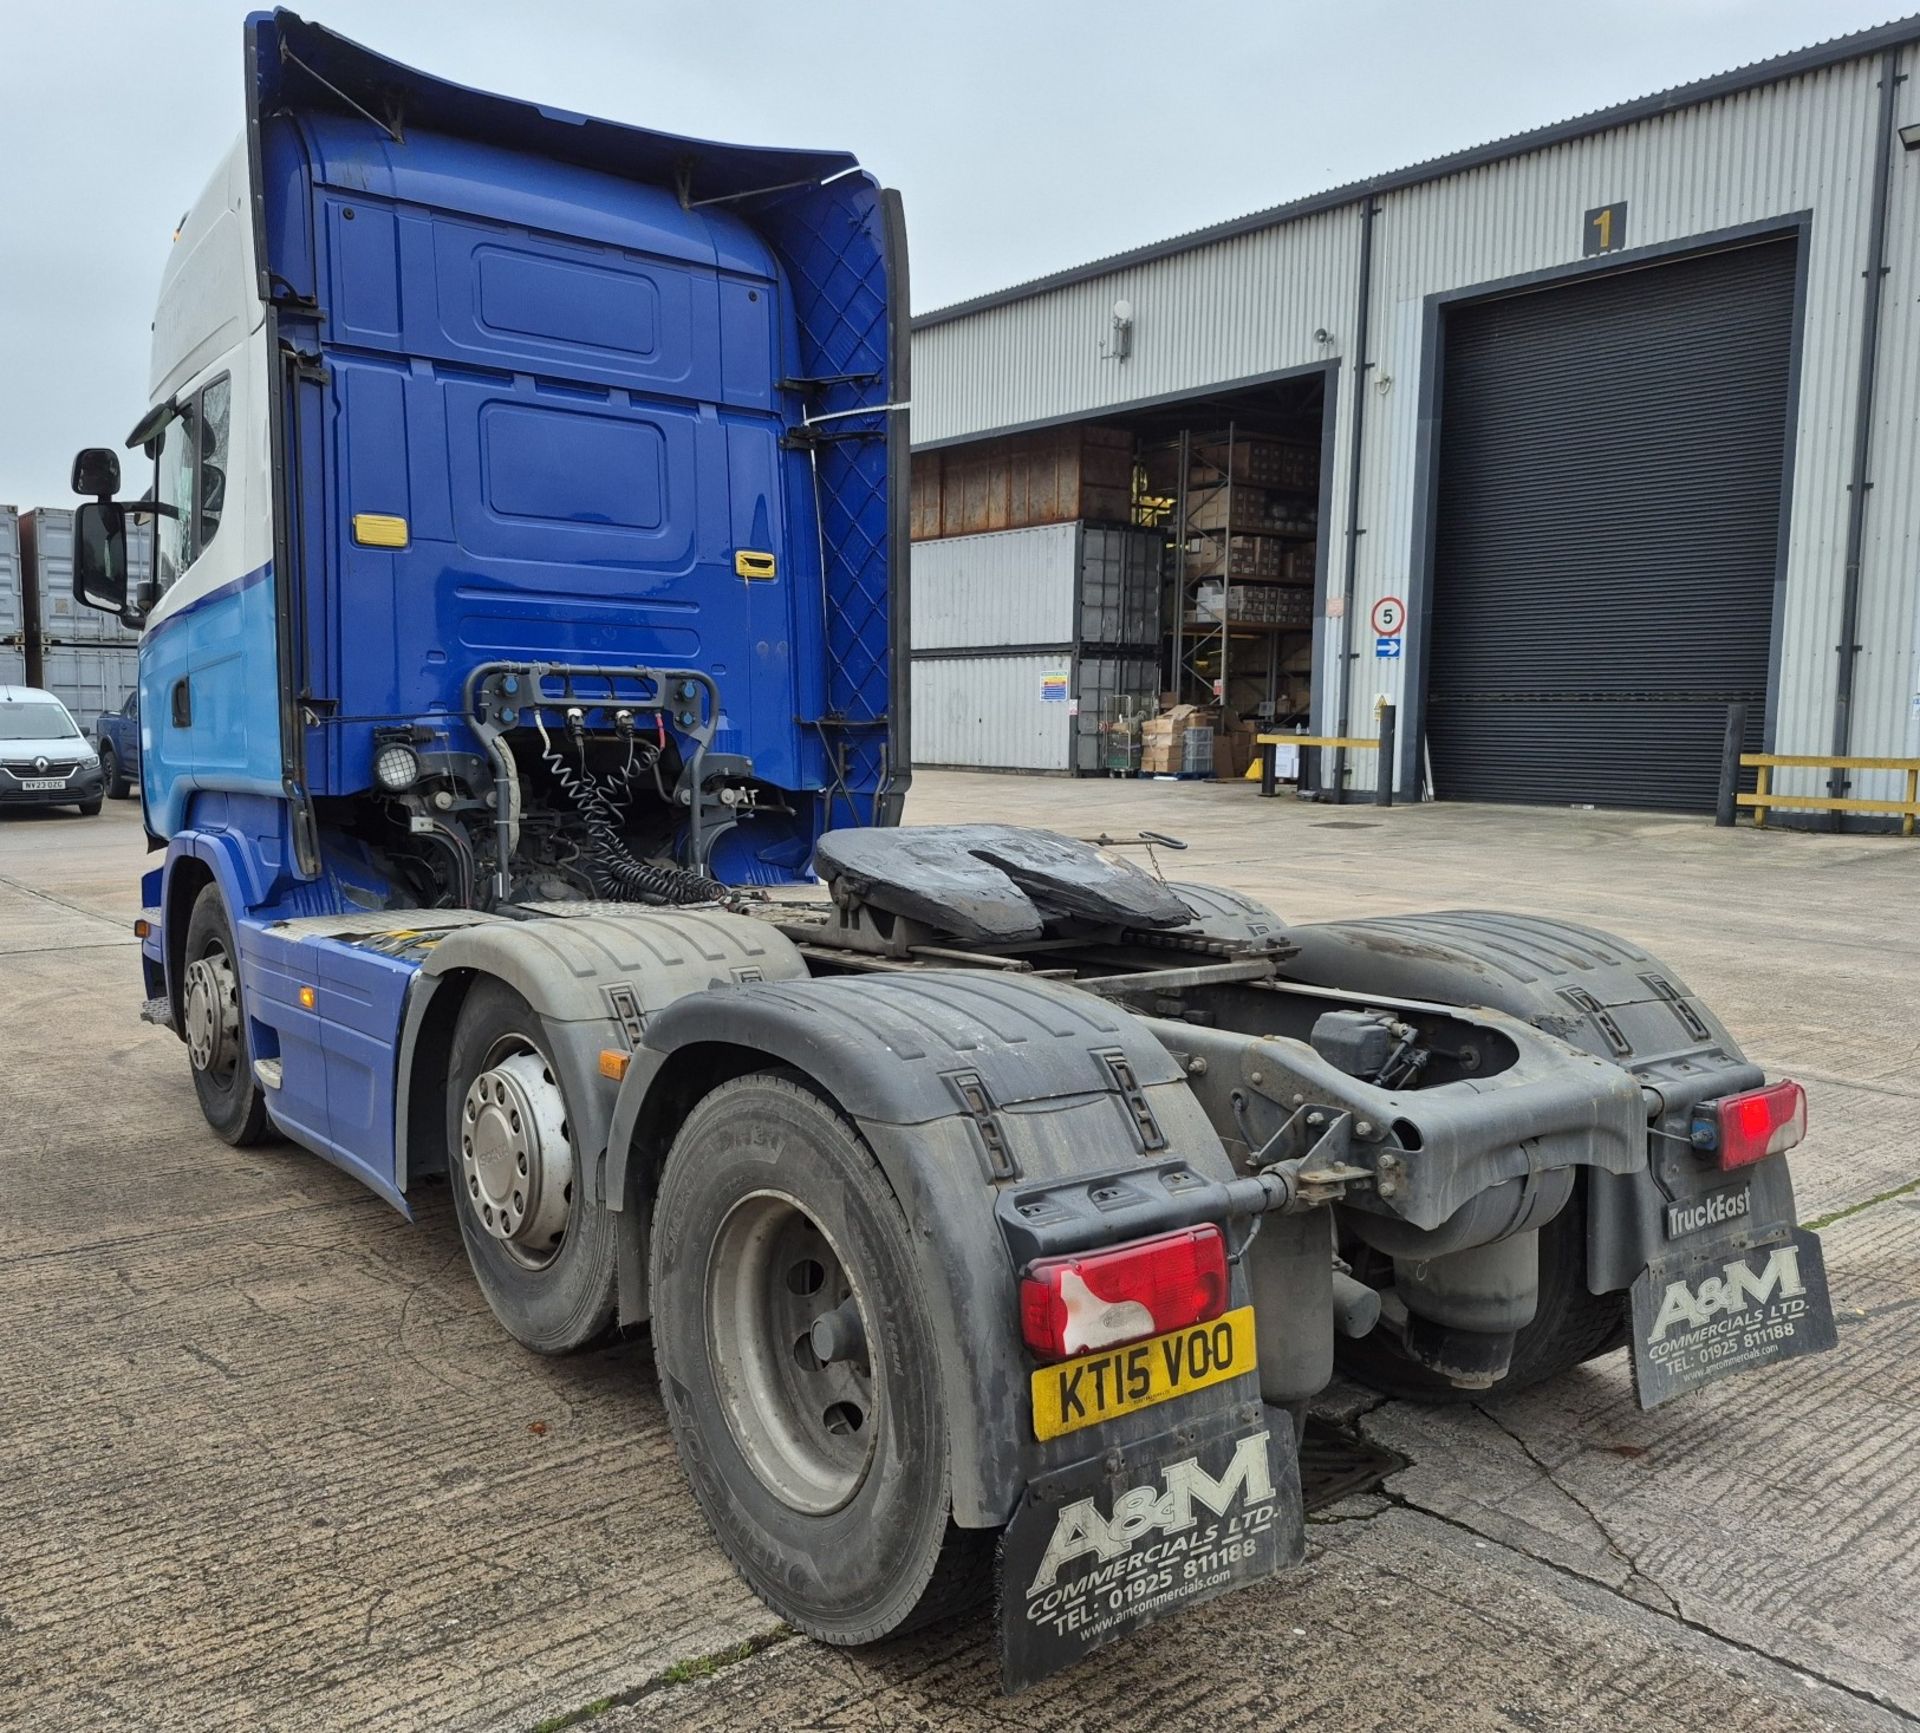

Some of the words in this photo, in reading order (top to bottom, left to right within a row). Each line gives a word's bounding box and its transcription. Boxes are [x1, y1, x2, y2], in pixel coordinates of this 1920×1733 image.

[1593, 209, 1611, 248] 1
[1383, 608, 1393, 625] 5
[1668, 1186, 1751, 1236] TruckEast
[1647, 1245, 1806, 1344] A&M
[1649, 1309, 1764, 1360] COMMERCIALS
[1770, 1299, 1811, 1318] LTD.
[1666, 1355, 1695, 1376] TEL:
[1700, 1340, 1738, 1363] 01925
[1744, 1322, 1795, 1348] 811188
[1059, 1347, 1150, 1423] KT15
[1162, 1321, 1233, 1387] VOO
[1683, 1344, 1779, 1382] www.amcommercials.com
[1026, 1430, 1277, 1599] A&M
[1026, 1524, 1219, 1621] COMMERCIALS
[1228, 1505, 1279, 1535] LTD.
[1053, 1602, 1099, 1637] TEL:
[1109, 1568, 1173, 1609] 01925
[1183, 1538, 1256, 1578] 811188
[1080, 1569, 1231, 1641] www.amcommercials.com
